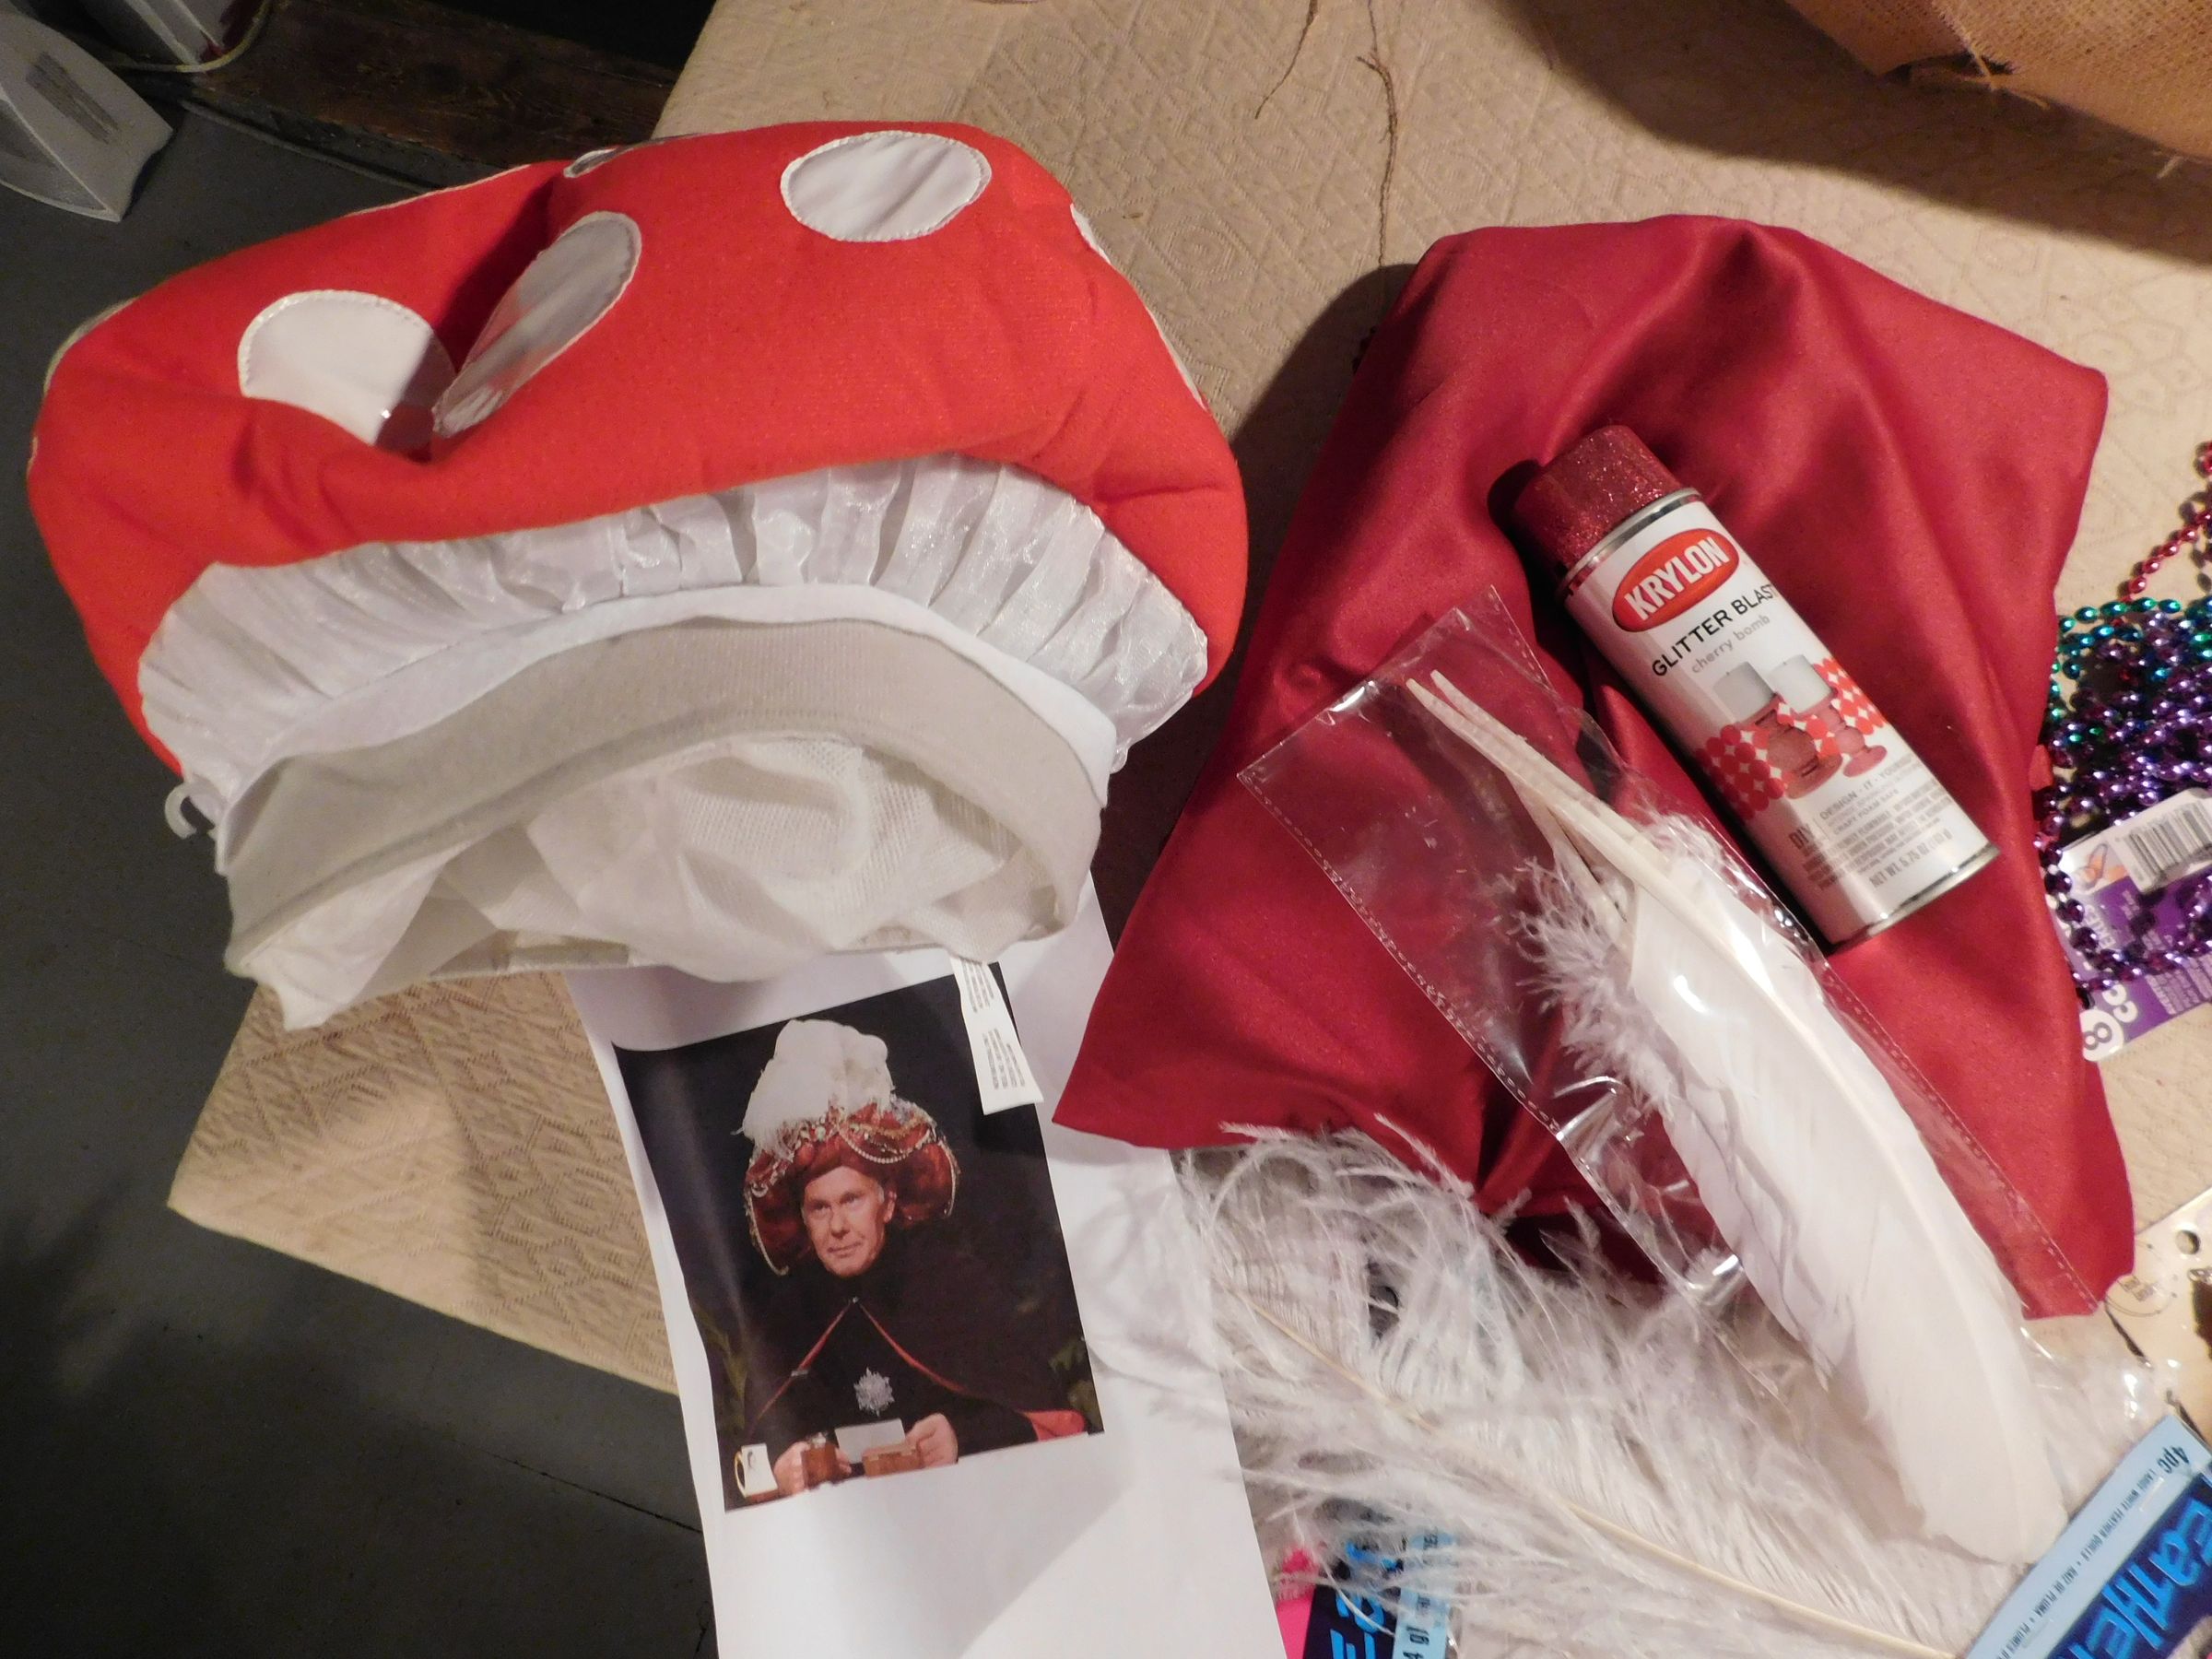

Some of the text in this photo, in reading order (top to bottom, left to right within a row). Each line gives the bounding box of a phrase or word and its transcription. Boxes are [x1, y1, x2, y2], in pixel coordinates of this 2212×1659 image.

[1624, 536, 1730, 620] KRYLON
[1652, 609, 1733, 677] GLITTER
[1691, 614, 1771, 674] cherry bomb
[1789, 823, 1816, 850] DIY
[2083, 1021, 2112, 1051] 8
[2157, 1445, 2190, 1474] 4pc
